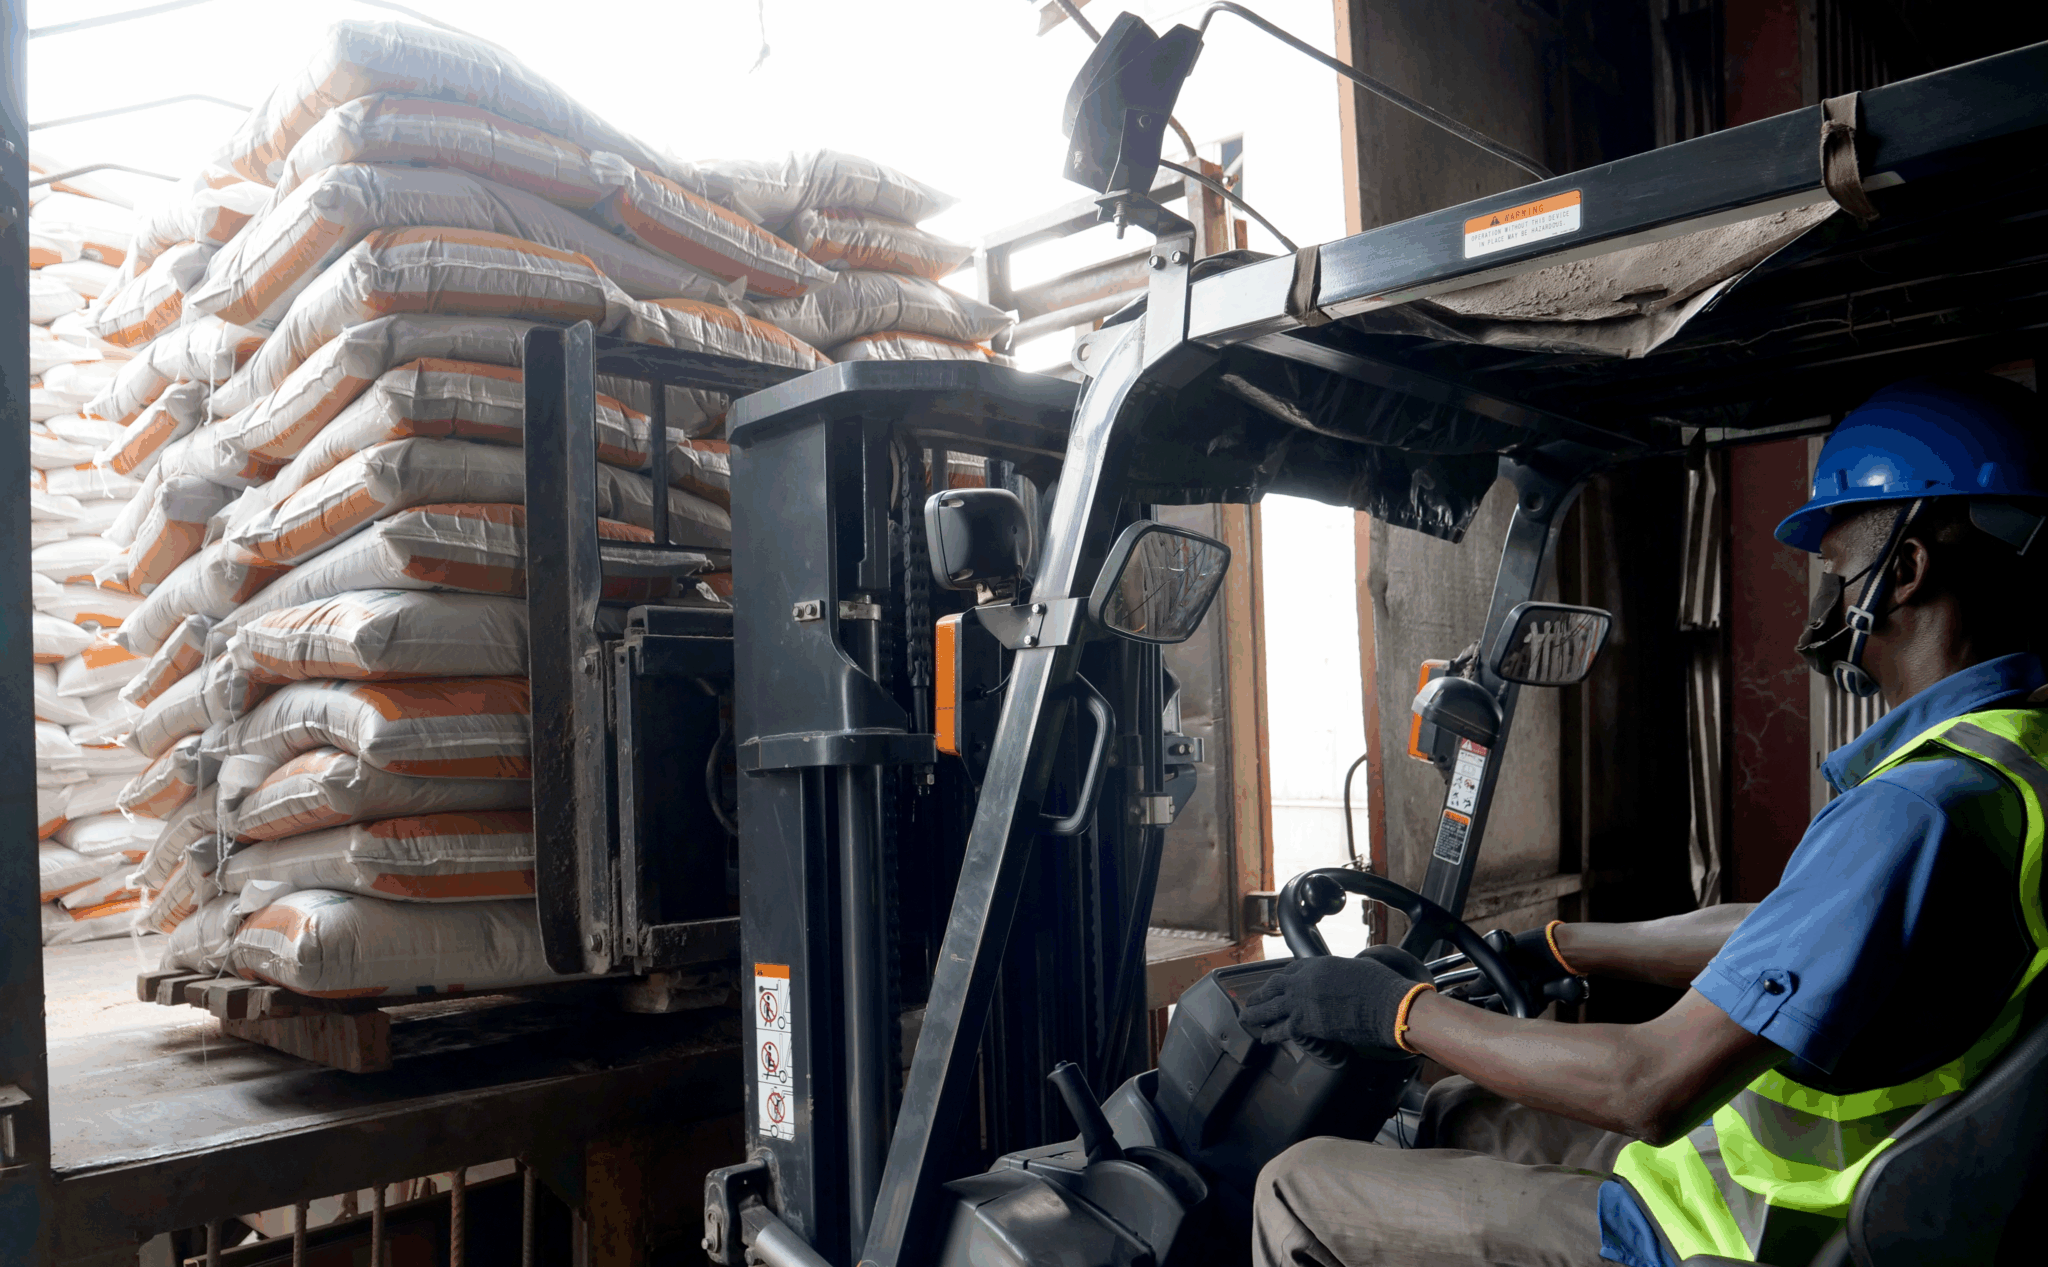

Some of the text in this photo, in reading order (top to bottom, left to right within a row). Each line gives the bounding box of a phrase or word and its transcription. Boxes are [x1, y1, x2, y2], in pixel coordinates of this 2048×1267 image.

[1504, 204, 1544, 221] WARNING
[1471, 210, 1570, 242] OPERATION WITHOUT THIS DEVICE
[1487, 235, 1504, 245] PLACE
[1521, 229, 1528, 237] BE
[1531, 220, 1566, 233] HAZARDOUS.
